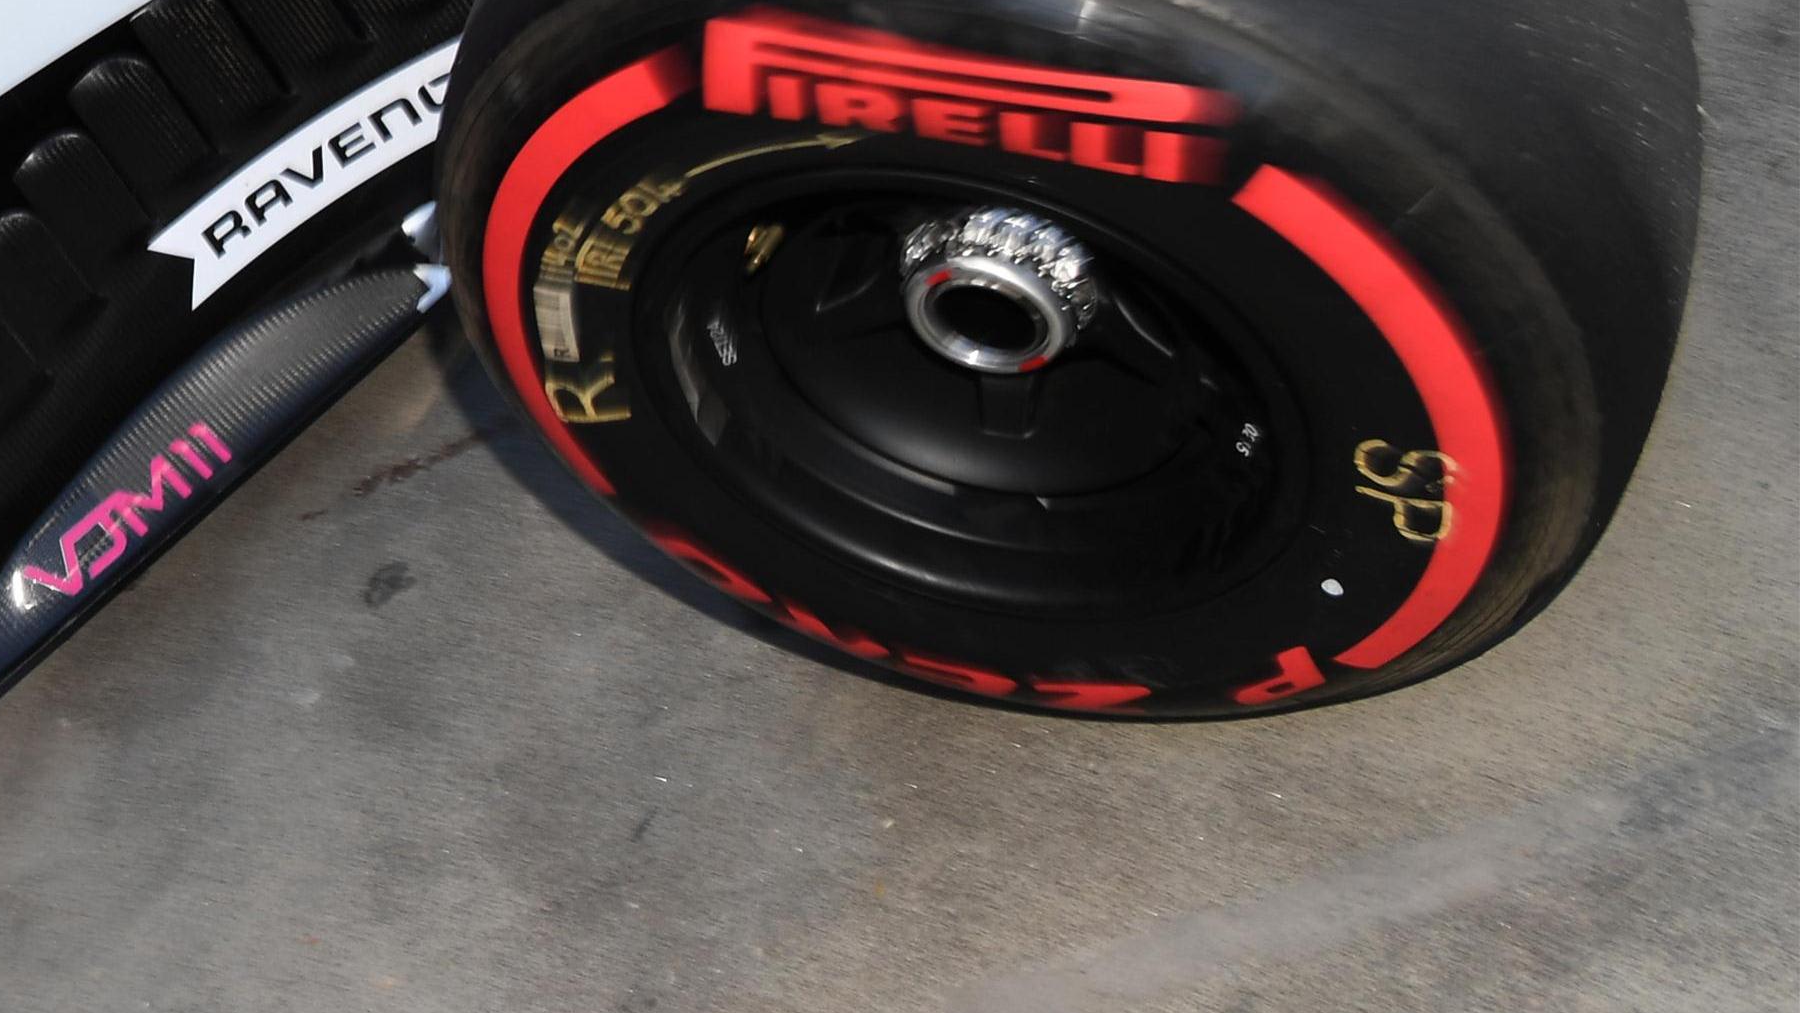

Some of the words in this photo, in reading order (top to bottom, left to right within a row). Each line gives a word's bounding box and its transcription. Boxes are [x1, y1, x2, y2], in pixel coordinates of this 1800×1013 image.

[201, 72, 457, 260] RAVENO
[701, 13, 1236, 185] PIRELLI
[1232, 646, 1328, 706] P
